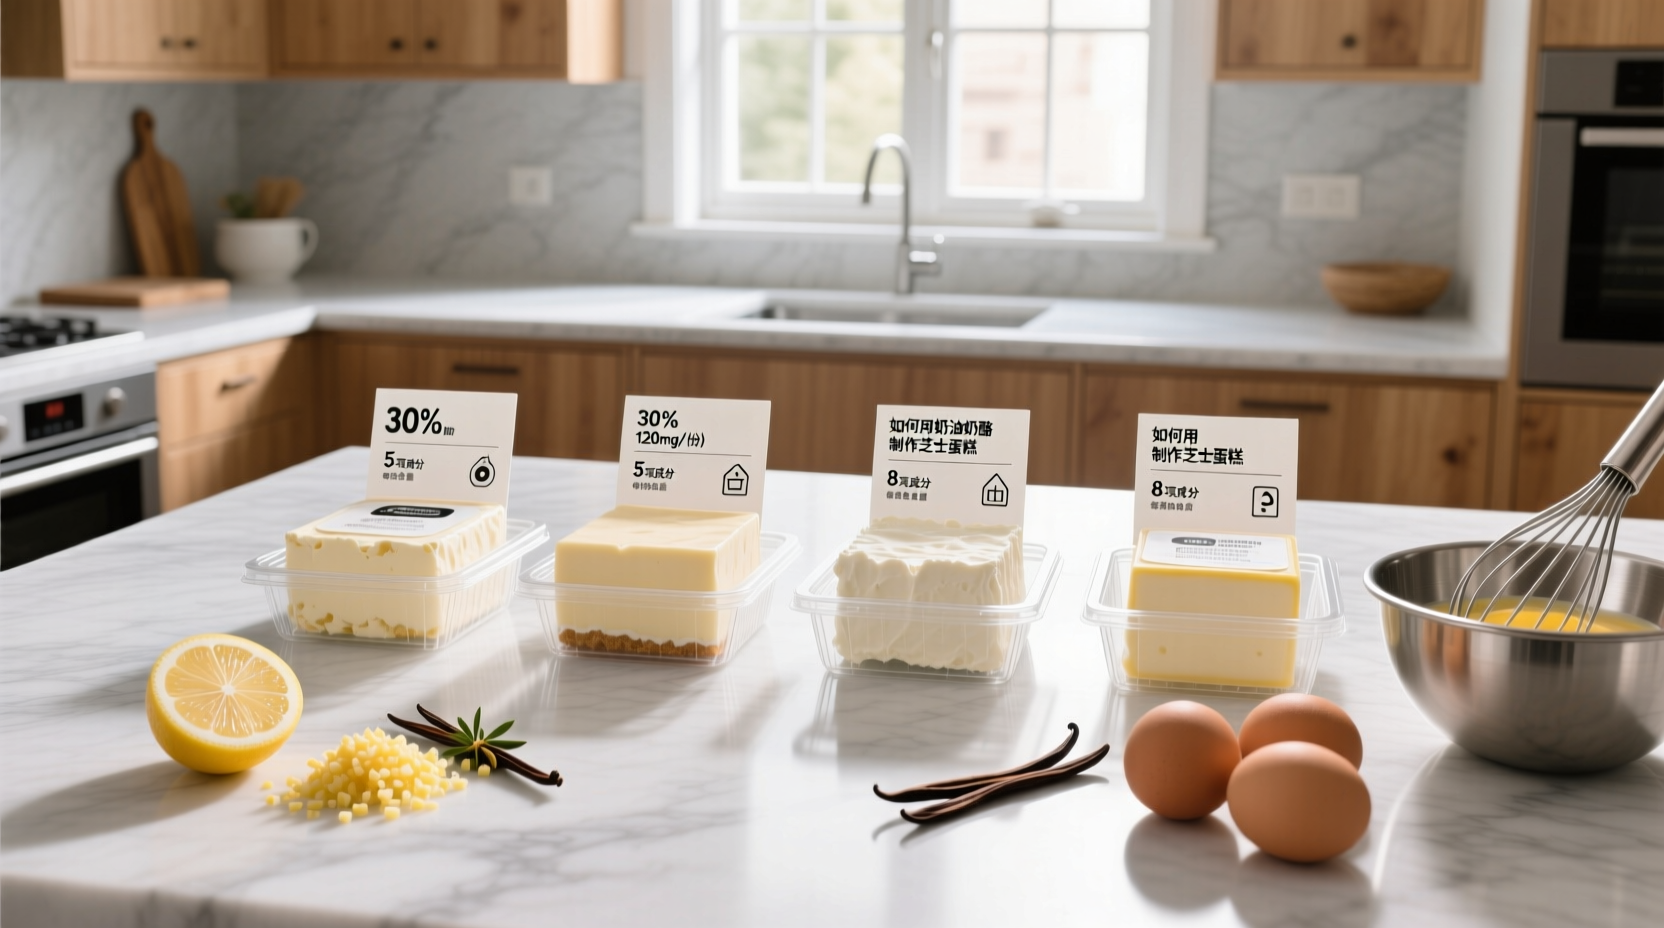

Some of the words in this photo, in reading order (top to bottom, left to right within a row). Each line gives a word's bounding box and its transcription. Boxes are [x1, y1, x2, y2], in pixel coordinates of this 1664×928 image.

[385, 406, 442, 434] 30%
[637, 409, 679, 428] 30%
[1151, 426, 1198, 445] 如何用
[889, 436, 978, 455] 制作芝士蛋糕
[1151, 446, 1244, 466] 制作芝士蛋糕
